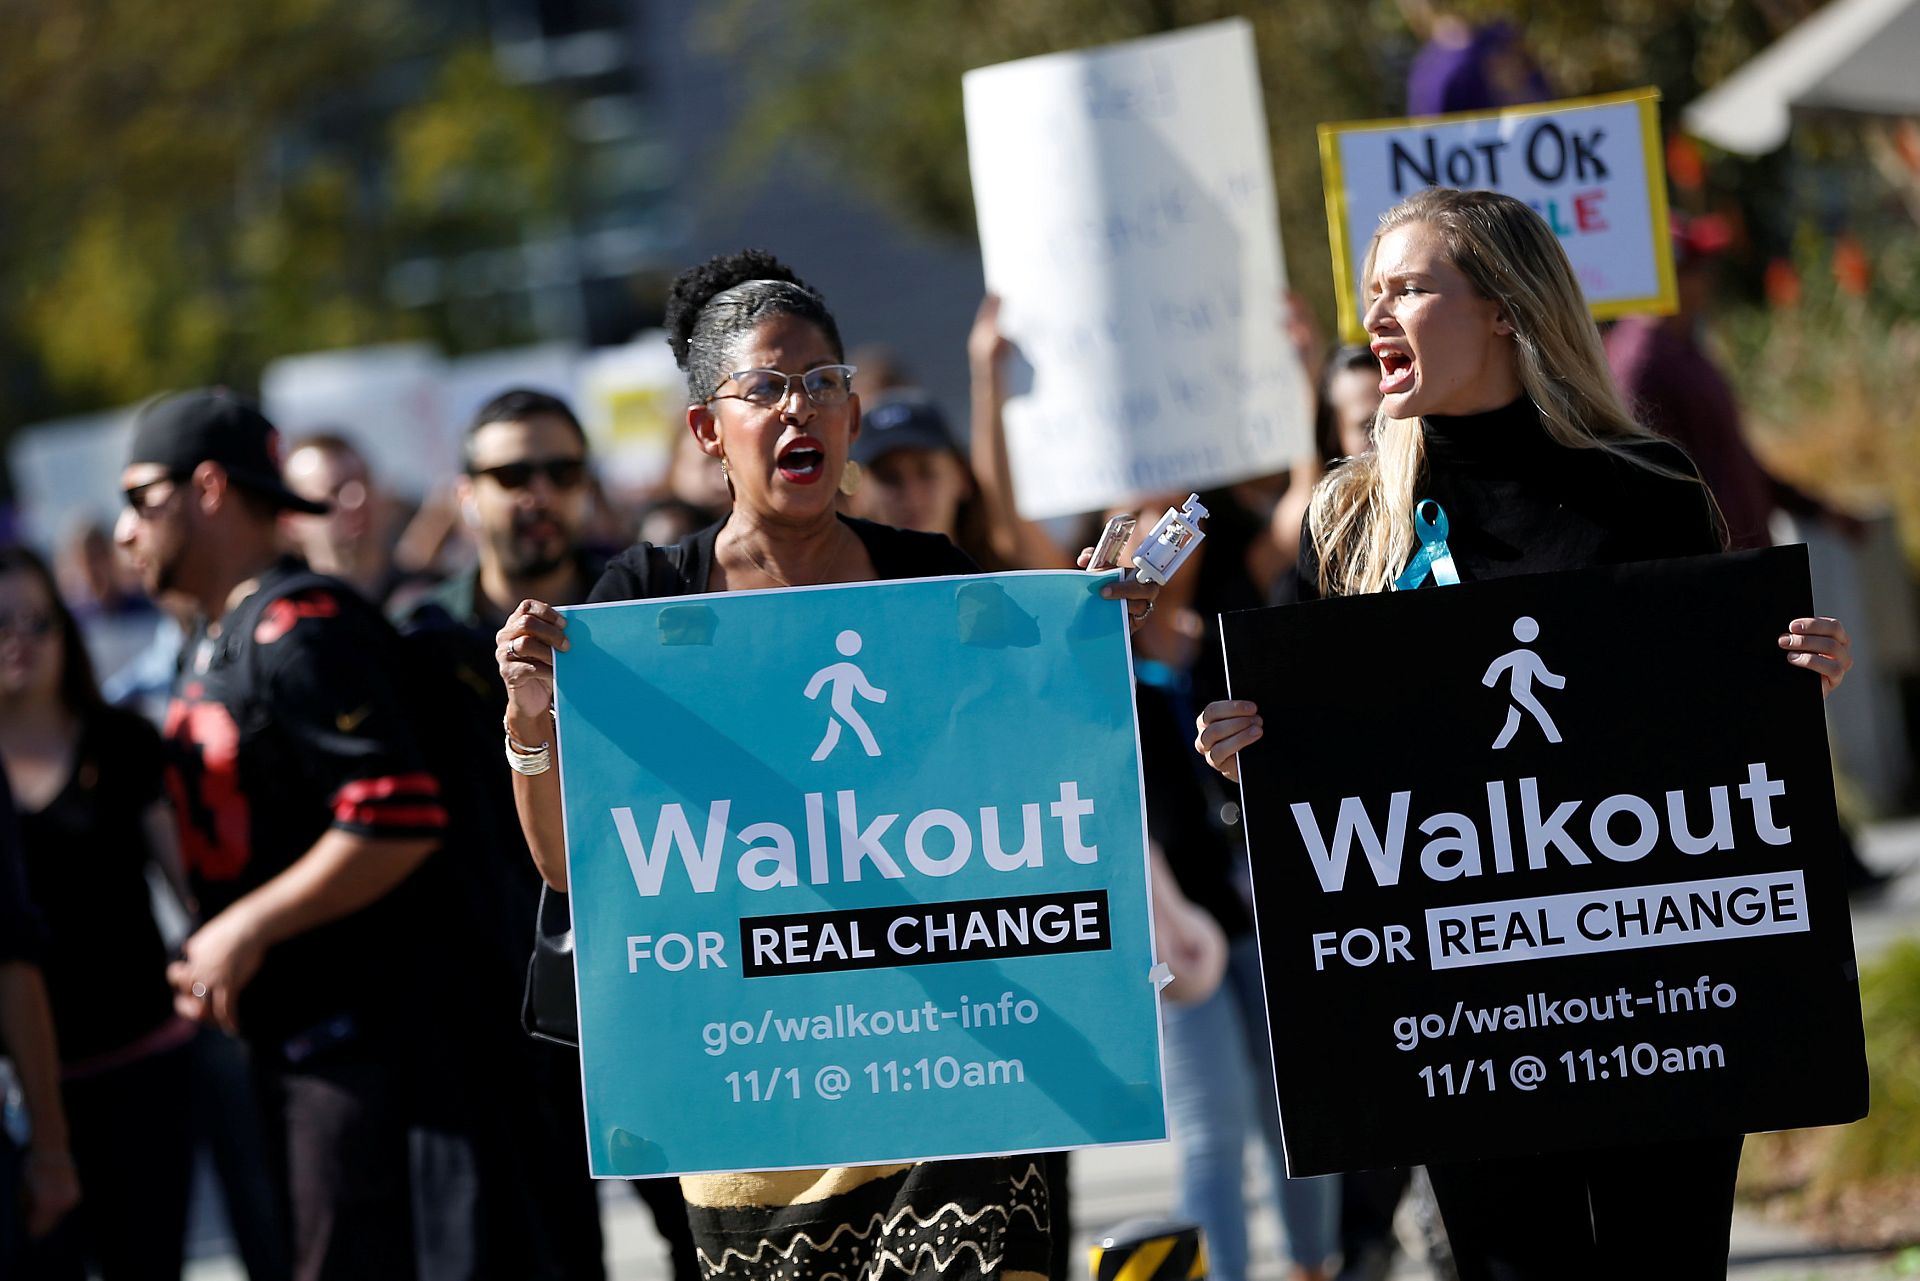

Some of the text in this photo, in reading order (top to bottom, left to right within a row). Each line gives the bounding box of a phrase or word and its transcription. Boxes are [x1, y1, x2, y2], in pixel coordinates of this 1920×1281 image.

[610, 781, 1099, 896] Walkout
[1290, 763, 1792, 893] Walkout
[627, 902, 1101, 973] FOR REAL CHANGE
[1312, 883, 1799, 971] FOR REAL CHANGE
[702, 991, 1040, 1056] go/walkout-info
[1393, 976, 1738, 1051] go/walkout-info
[724, 1055, 1025, 1103] 11/1 @ 11:10am
[1418, 1042, 1726, 1099] 11/1 @ 11:10am
